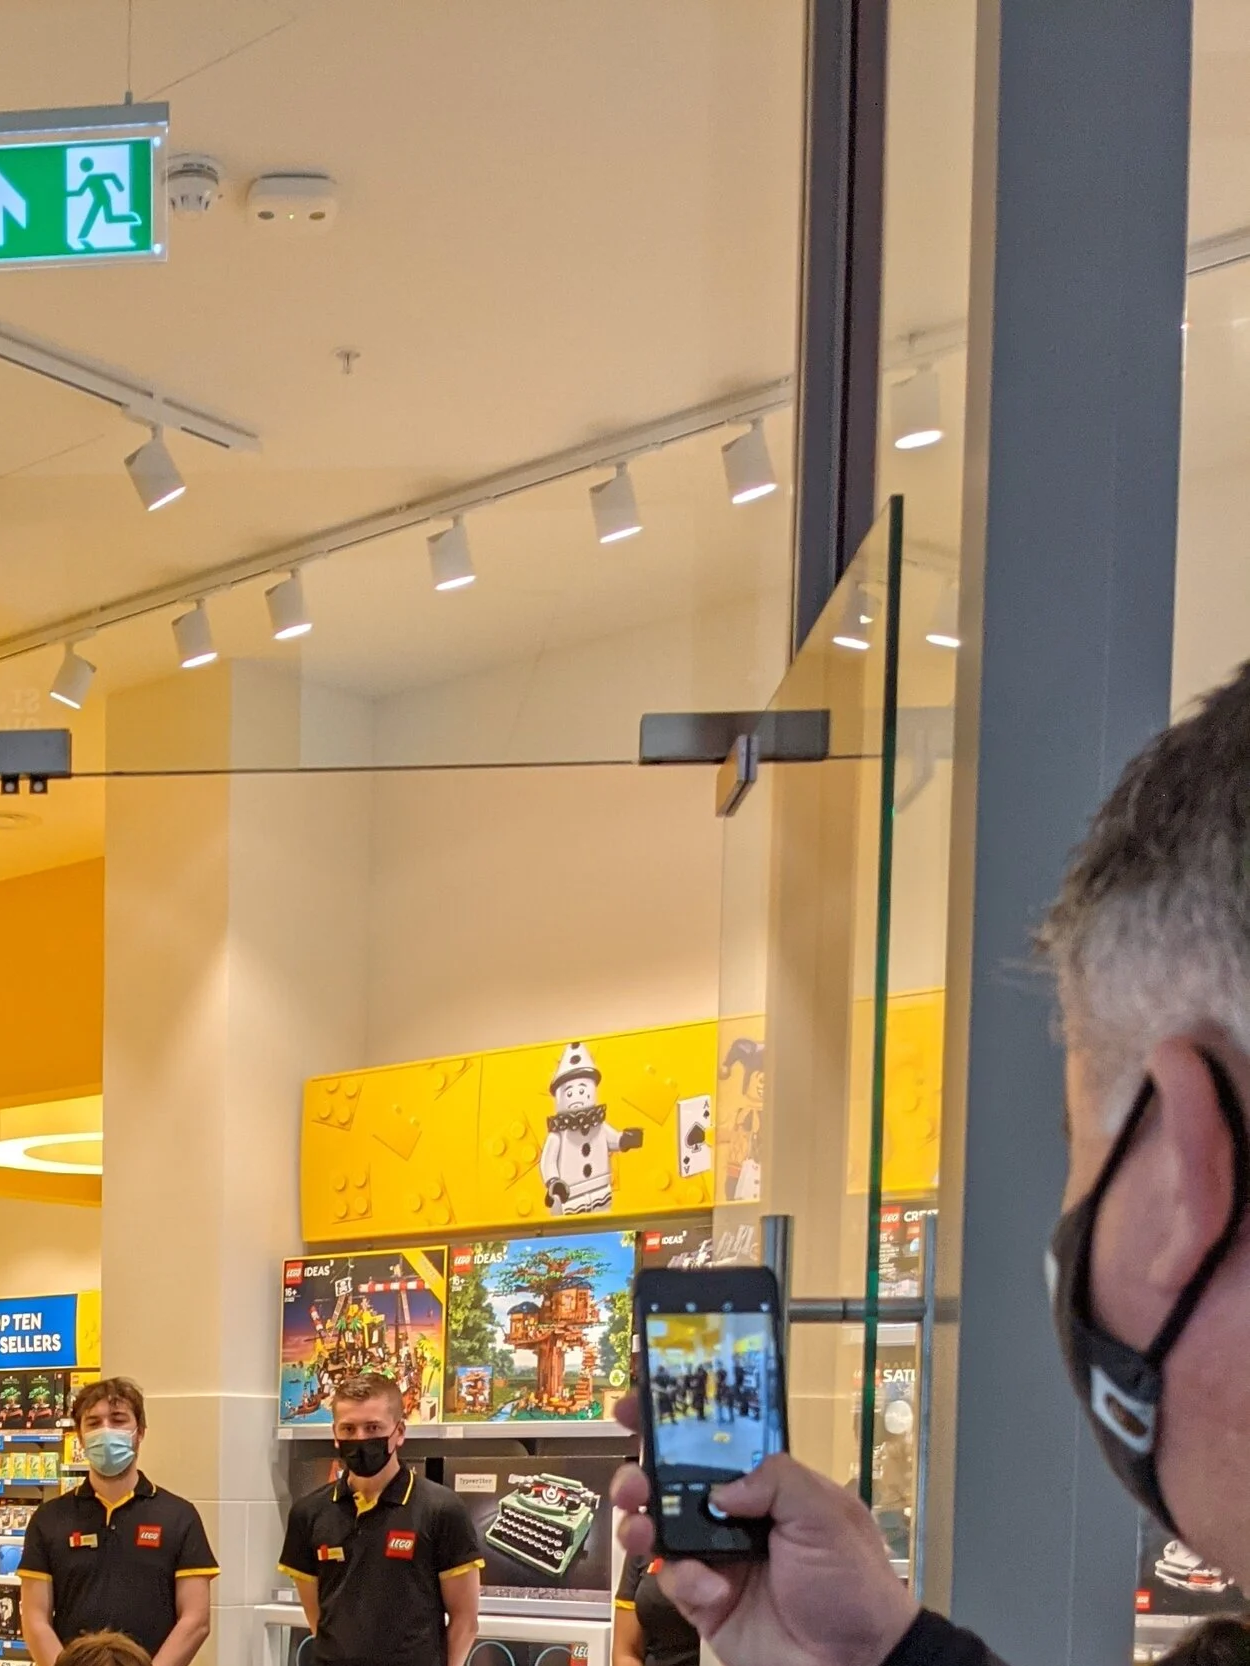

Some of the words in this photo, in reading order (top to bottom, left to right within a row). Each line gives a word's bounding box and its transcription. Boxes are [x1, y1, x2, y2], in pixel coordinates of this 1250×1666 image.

[661, 1235, 684, 1246] IDEAS
[454, 1256, 471, 1266] LEGO
[473, 1253, 503, 1265] IDEAS
[286, 1268, 302, 1279] LEGO
[304, 1265, 330, 1278] IDEAS
[12, 1312, 43, 1331] TEN
[0, 1333, 62, 1354] SELLERS
[459, 1477, 493, 1486] Typewriter
[139, 1532, 159, 1540] LEGO
[387, 1537, 414, 1550] LEGO
